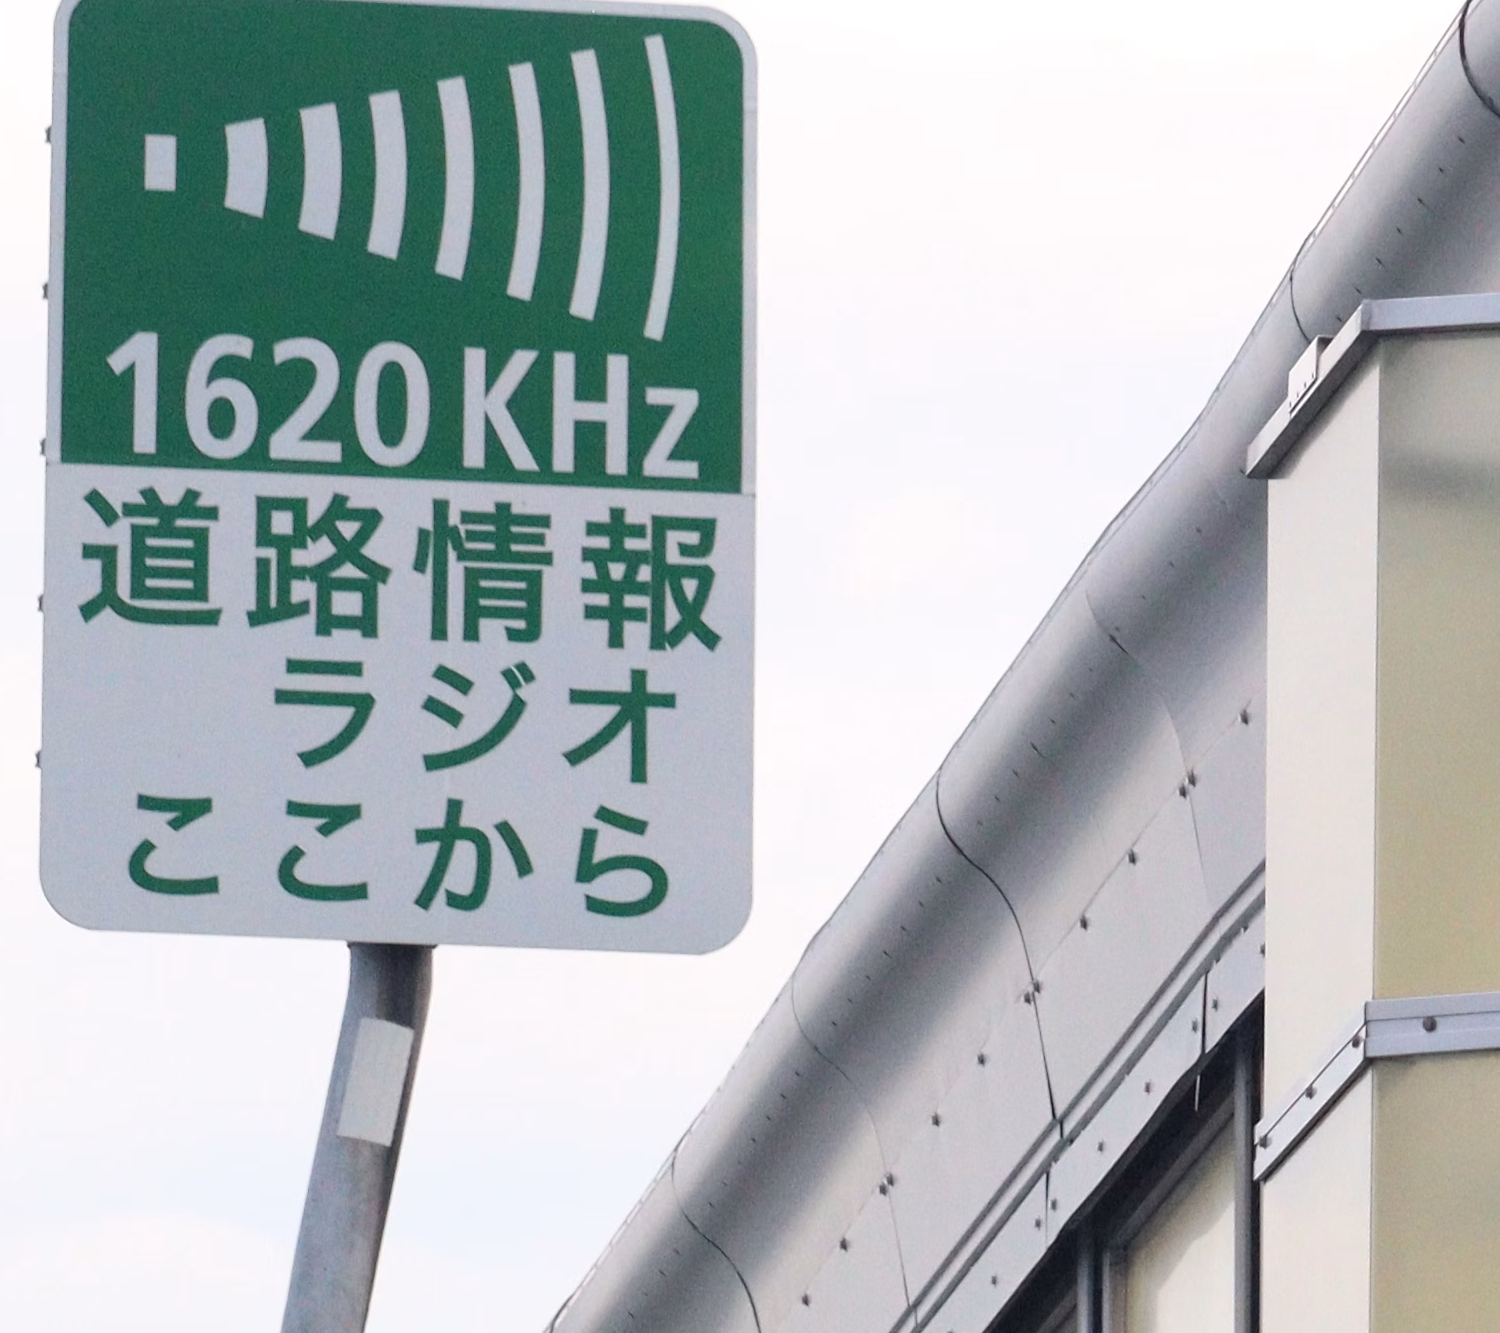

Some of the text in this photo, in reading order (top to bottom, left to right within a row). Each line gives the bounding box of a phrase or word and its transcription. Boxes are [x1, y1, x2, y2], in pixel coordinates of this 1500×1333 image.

[104, 330, 701, 479] 1620 KHz
[77, 486, 720, 653] 道路情報
[272, 656, 678, 785] ラジオ
[126, 791, 670, 918] ここから
